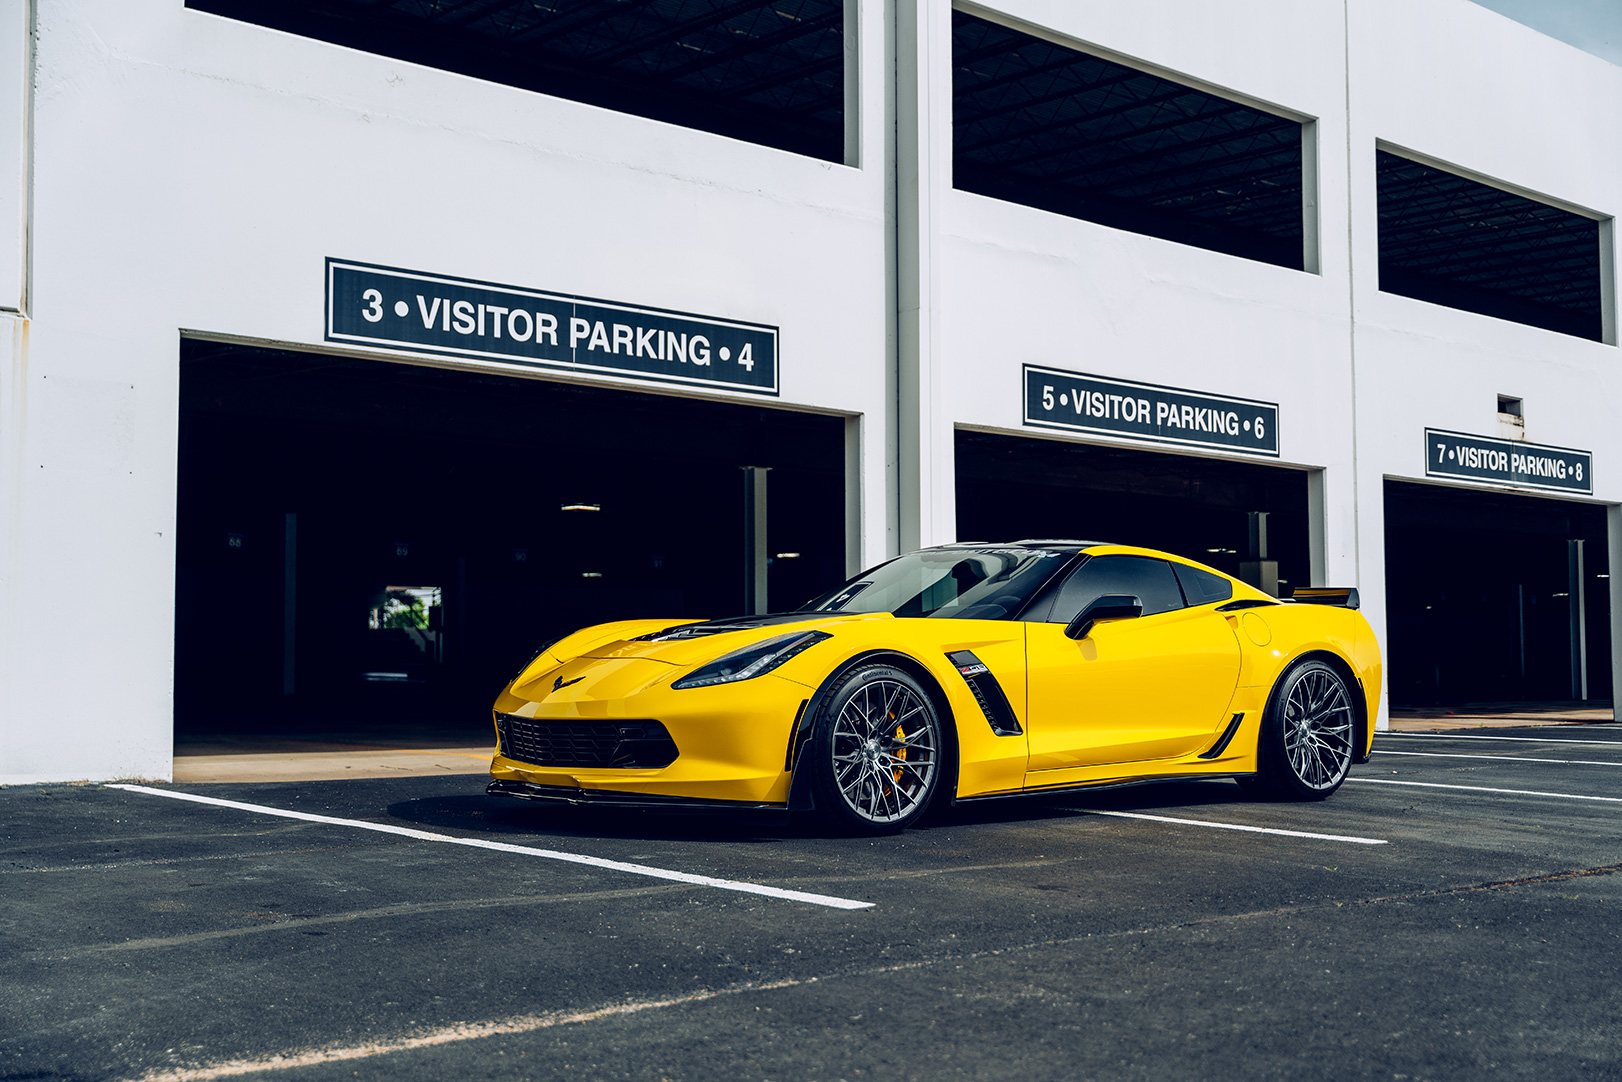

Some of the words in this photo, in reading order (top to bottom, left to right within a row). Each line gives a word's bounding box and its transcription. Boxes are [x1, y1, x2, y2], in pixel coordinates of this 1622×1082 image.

[361, 288, 384, 323] 3
[416, 294, 559, 347] VISITOR
[569, 316, 711, 367] PARKING
[737, 342, 755, 372] 4
[1042, 385, 1055, 411] 5
[1071, 388, 1151, 425] VISITOR
[1156, 401, 1239, 436] PARKING
[1254, 416, 1265, 440] 6
[1436, 443, 1446, 464] 7
[1455, 445, 1509, 472] VISITOR
[1511, 453, 1566, 480] PARKING
[1575, 462, 1583, 482] 8
